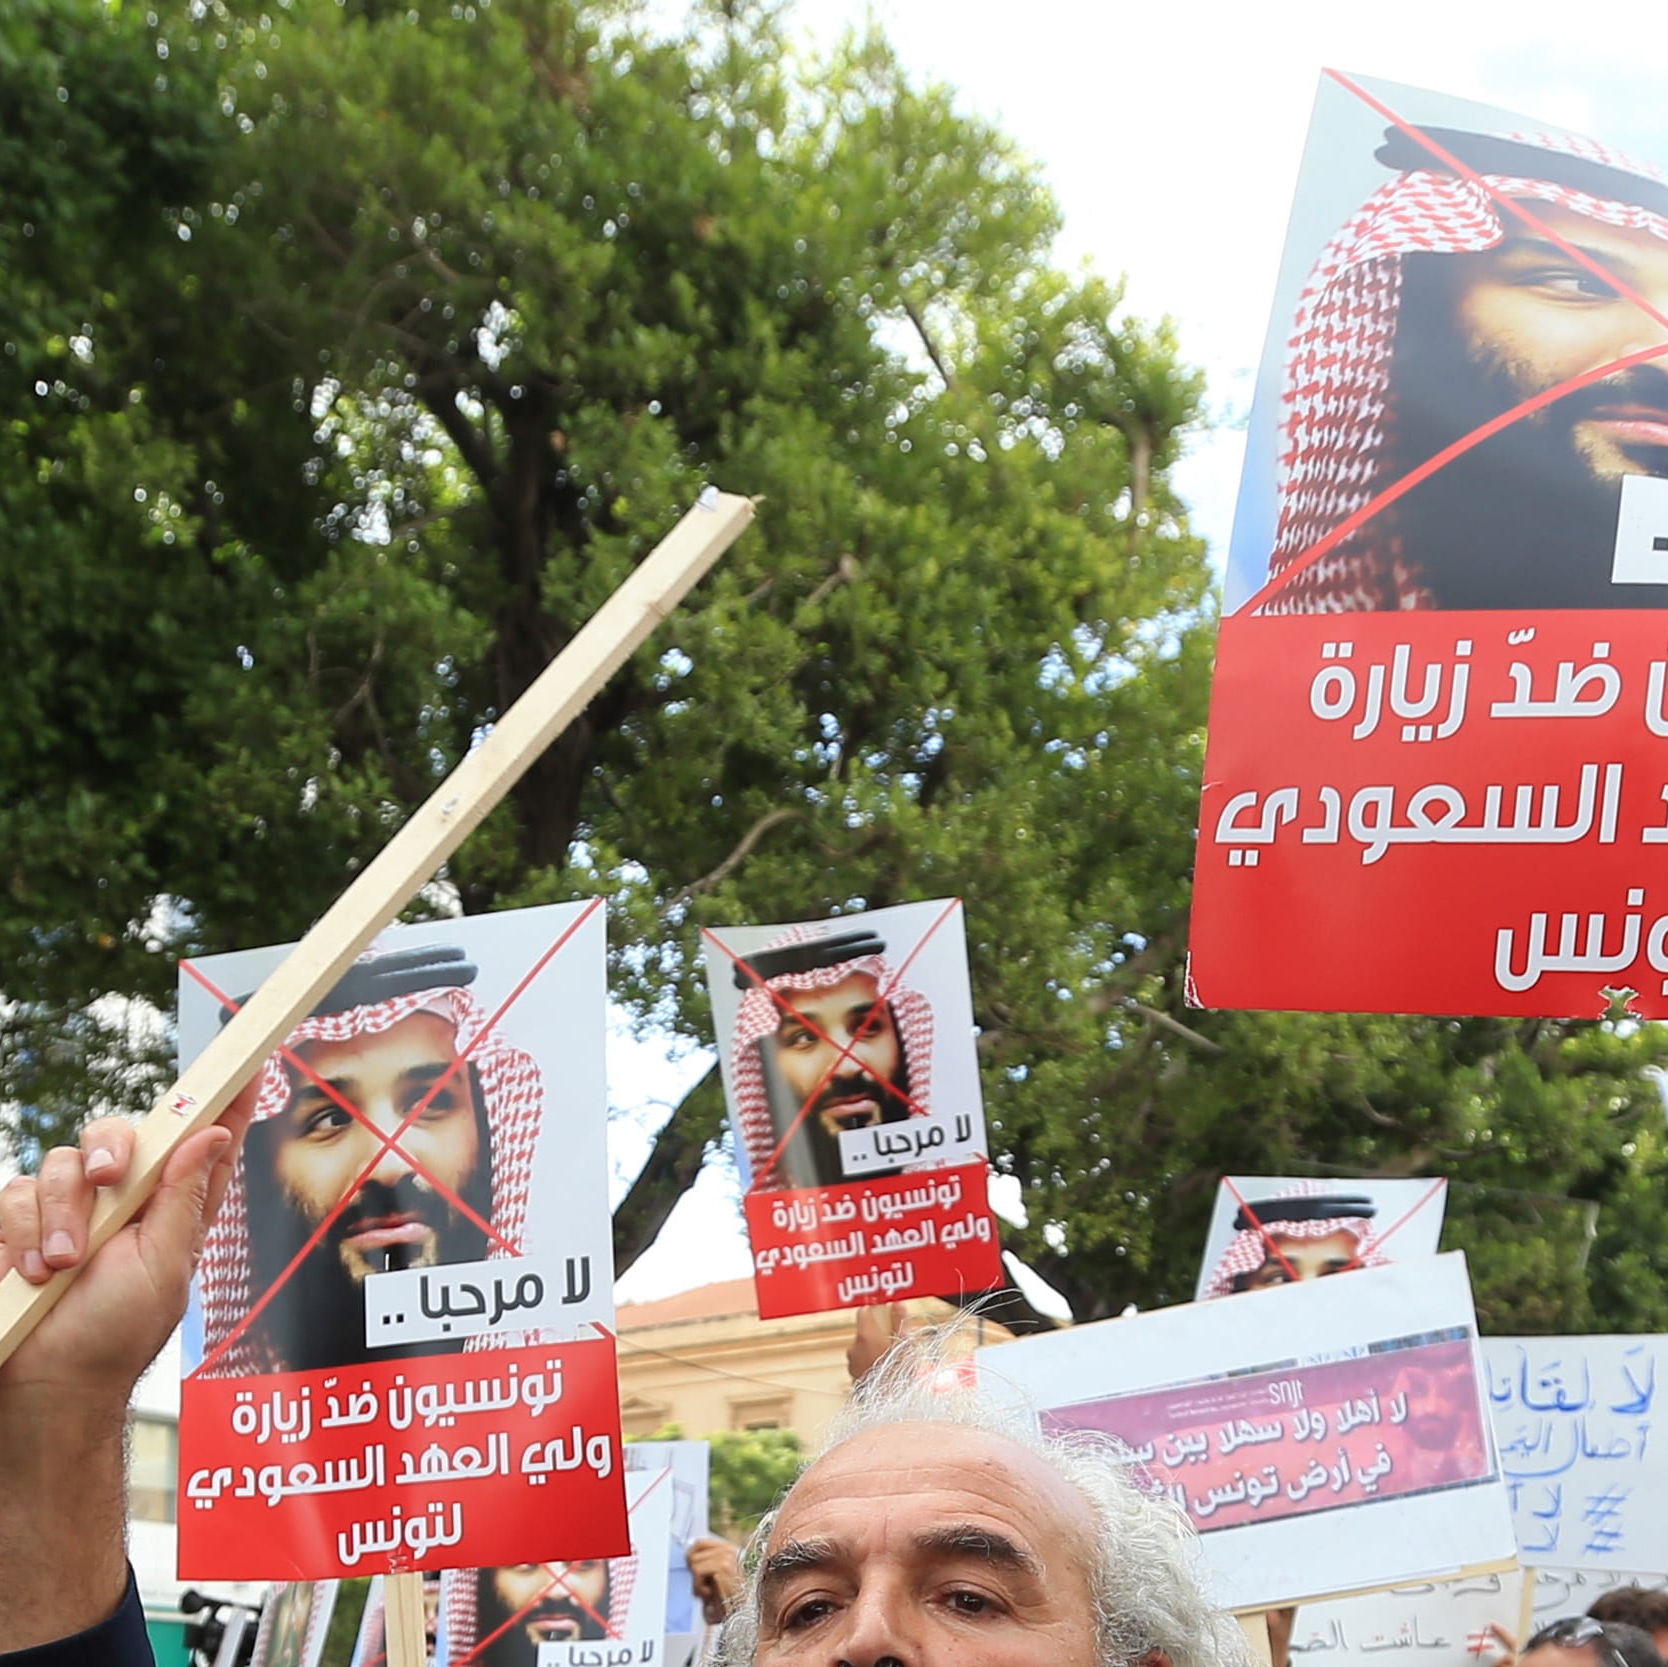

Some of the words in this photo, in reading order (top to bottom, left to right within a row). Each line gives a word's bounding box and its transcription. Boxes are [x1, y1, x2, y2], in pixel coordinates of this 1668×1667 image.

[1309, 640, 1472, 740] زيارة
[1214, 763, 1620, 865] السعودي
[873, 1125, 945, 1164] مرحبا
[954, 1113, 972, 1143] لا
[772, 1196, 818, 1232] زيارة
[861, 1175, 961, 1223] تونسيون
[755, 1231, 866, 1275] السعودي
[871, 1219, 936, 1254] العهد
[940, 1212, 991, 1249] ولي
[419, 1272, 544, 1332] مرحبا
[561, 1255, 591, 1305] لا
[838, 1261, 915, 1303] لتونس
[232, 1386, 312, 1444] زيارة
[388, 1359, 563, 1429] تونسيون
[1336, 1391, 1381, 1436] أهلا
[1388, 1391, 1409, 1425] لا
[1217, 1415, 1284, 1456] سهلا
[1292, 1407, 1328, 1443] ولا
[186, 1444, 386, 1510] السعودي
[394, 1431, 509, 1485] العهد
[520, 1425, 612, 1485] ولي
[1286, 1452, 1351, 1502] أرض
[1357, 1443, 1393, 1493] في
[1195, 1467, 1279, 1518] تونس
[337, 1502, 463, 1566] لتونس
[639, 1640, 655, 1664] لا
